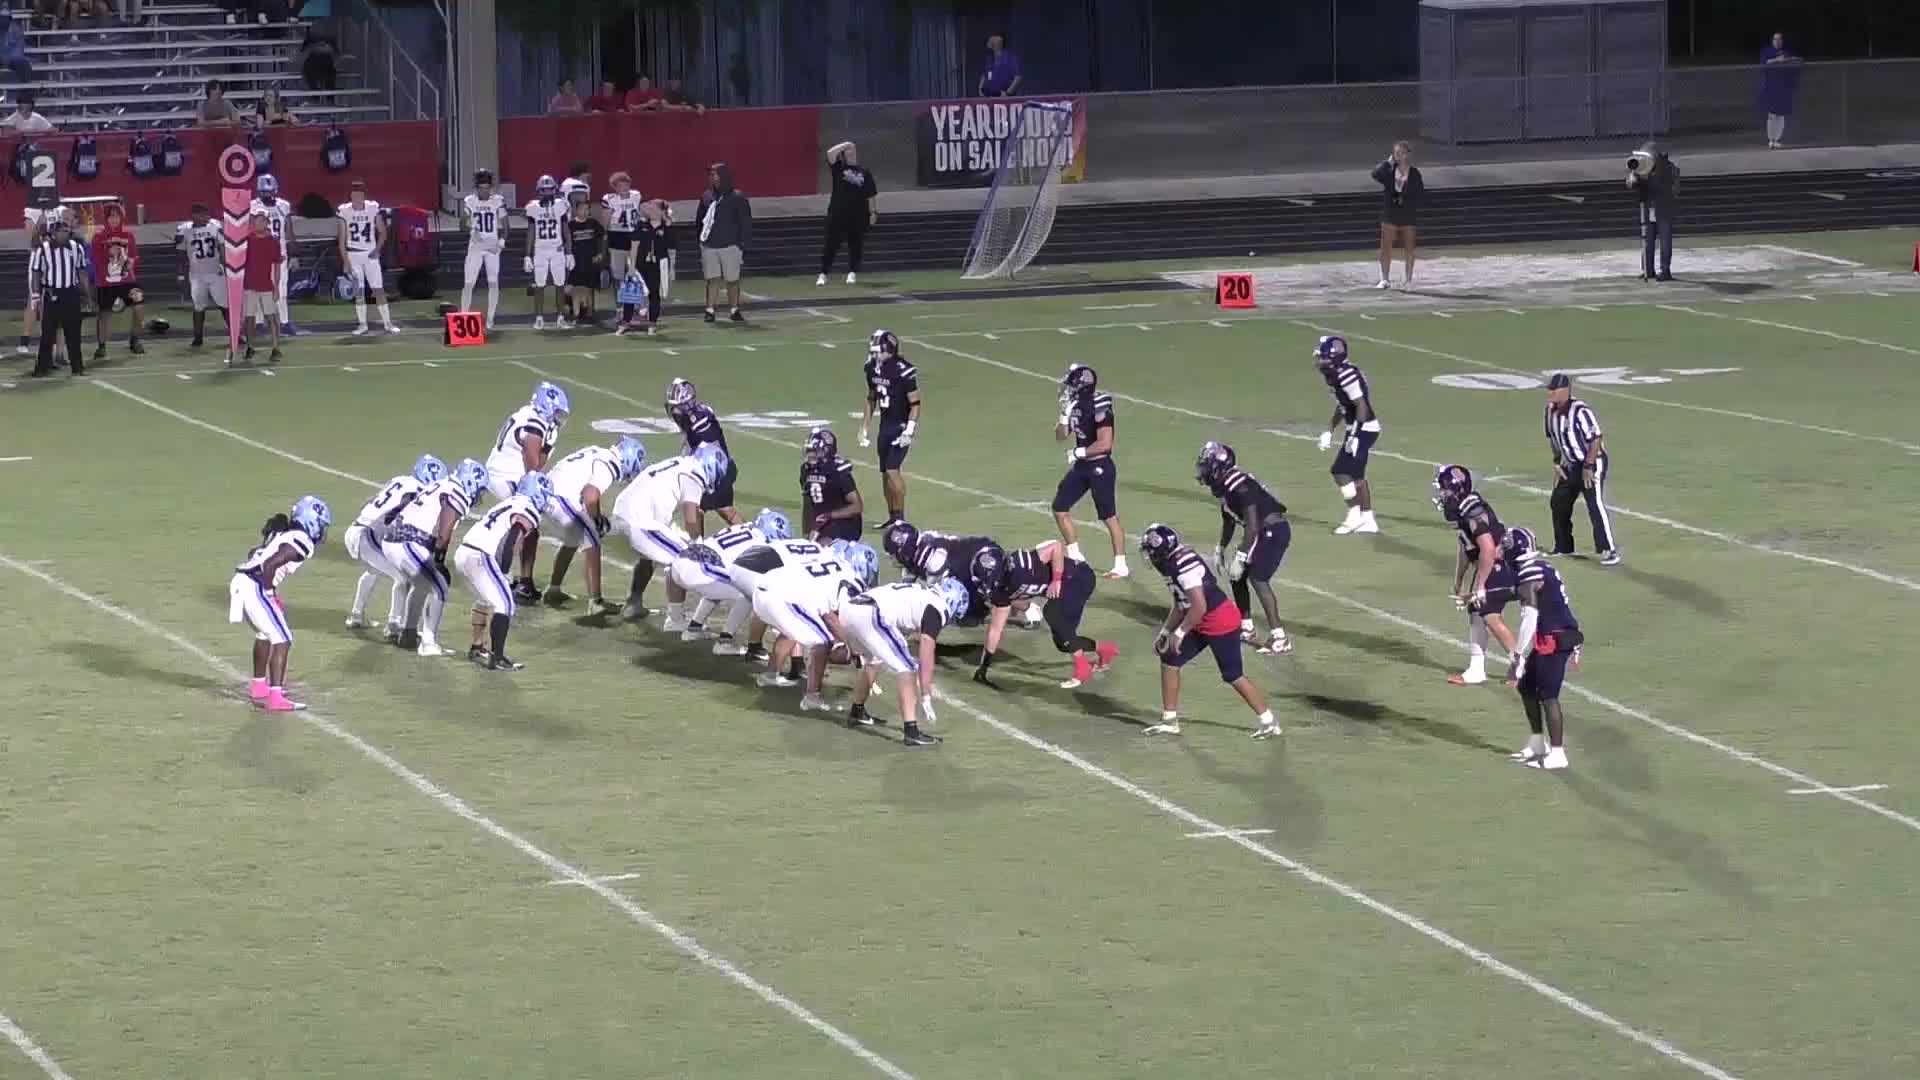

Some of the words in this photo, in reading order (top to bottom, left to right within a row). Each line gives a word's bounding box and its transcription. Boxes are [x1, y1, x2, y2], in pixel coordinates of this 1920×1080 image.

[935, 142, 963, 172] ON
[31, 155, 56, 188] 2
[349, 222, 372, 243] 24
[473, 211, 494, 233] 30
[537, 219, 558, 240] 22
[190, 236, 216, 260] 33
[1223, 277, 1250, 300] 20
[453, 315, 480, 338] 30
[876, 384, 890, 408] 3
[484, 504, 513, 531] 4
